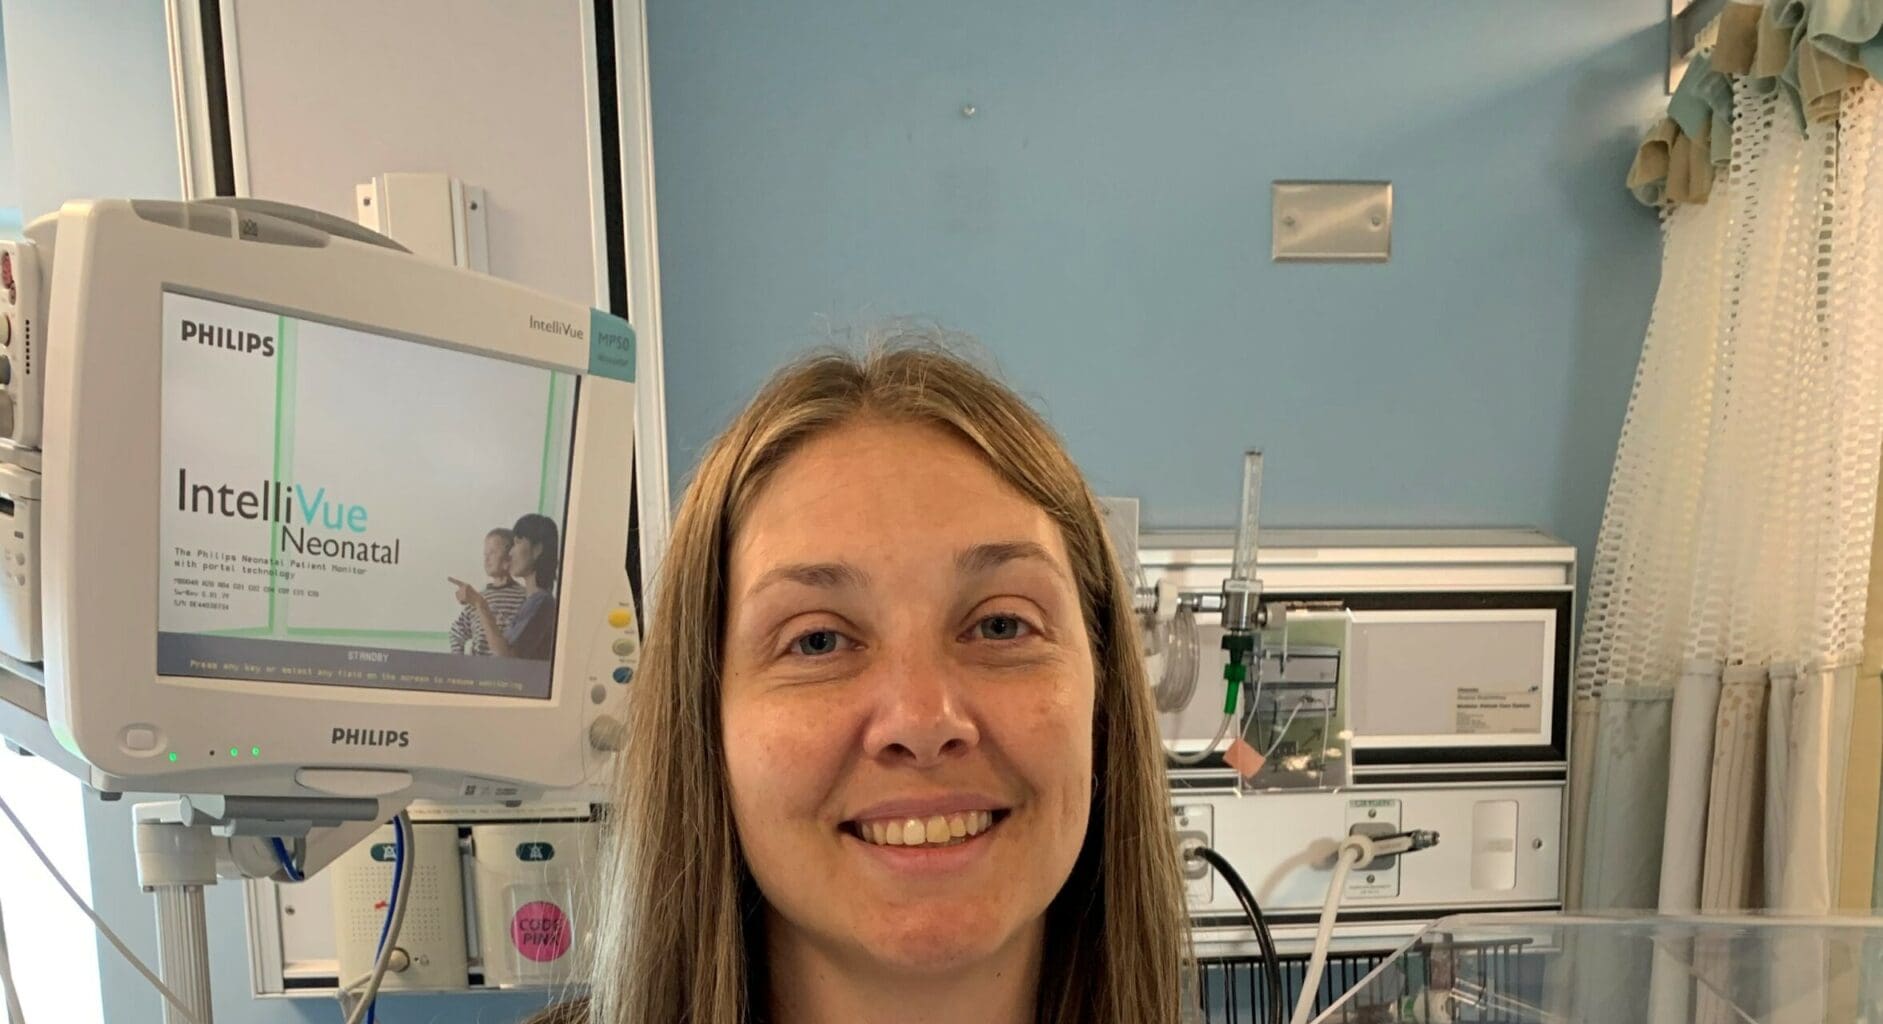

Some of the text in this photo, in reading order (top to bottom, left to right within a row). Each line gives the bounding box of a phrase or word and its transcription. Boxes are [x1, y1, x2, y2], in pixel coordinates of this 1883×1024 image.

[181, 319, 275, 357] PHILIPS
[528, 314, 584, 340] IntelliVue
[178, 468, 369, 533] IntelliVue
[281, 525, 400, 565] Neonatal
[174, 547, 367, 575] The Philips Neonatal Patient Monitor
[174, 560, 296, 580] with portal technology
[347, 651, 390, 663] STANDBY
[190, 659, 218, 670] Press
[223, 662, 239, 672] any
[244, 663, 261, 673] key
[266, 665, 277, 673] or
[317, 668, 333, 678] any
[382, 672, 396, 681] the
[331, 727, 410, 748] PHILIPS
[519, 917, 563, 932] CODE
[522, 932, 560, 946] PINK
